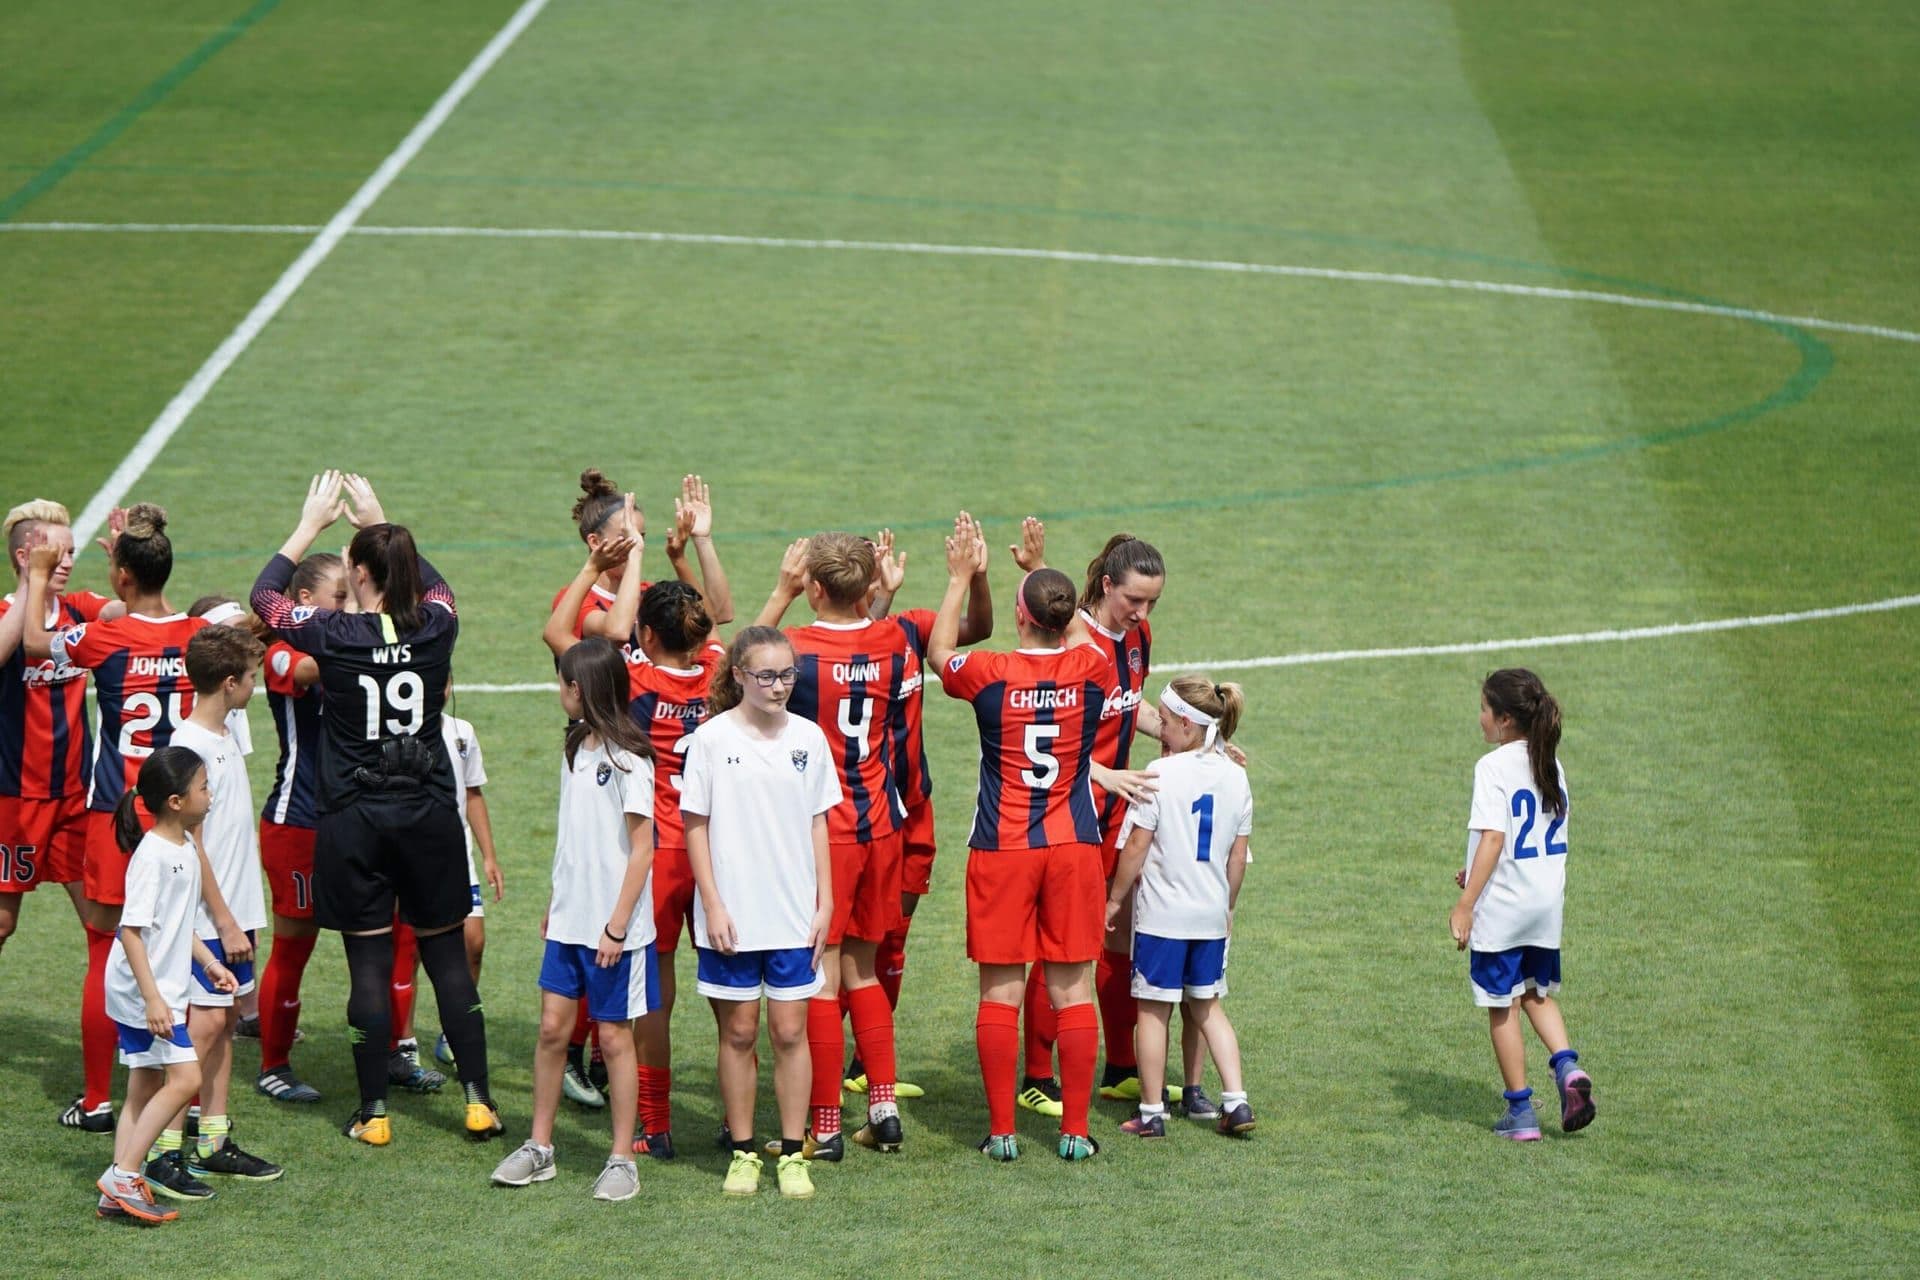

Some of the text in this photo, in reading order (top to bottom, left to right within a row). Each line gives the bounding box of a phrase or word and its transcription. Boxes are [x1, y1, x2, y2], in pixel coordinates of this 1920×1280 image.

[372, 644, 412, 664] WYS
[832, 662, 880, 685] QUINN
[358, 670, 424, 740] 19
[655, 701, 709, 719] DYDAS
[1010, 687, 1077, 709] CHURCH
[838, 698, 874, 763] 4
[1021, 724, 1060, 789] 5
[1192, 794, 1214, 862] 1
[1511, 788, 1568, 860] 22
[0, 844, 36, 883] 15
